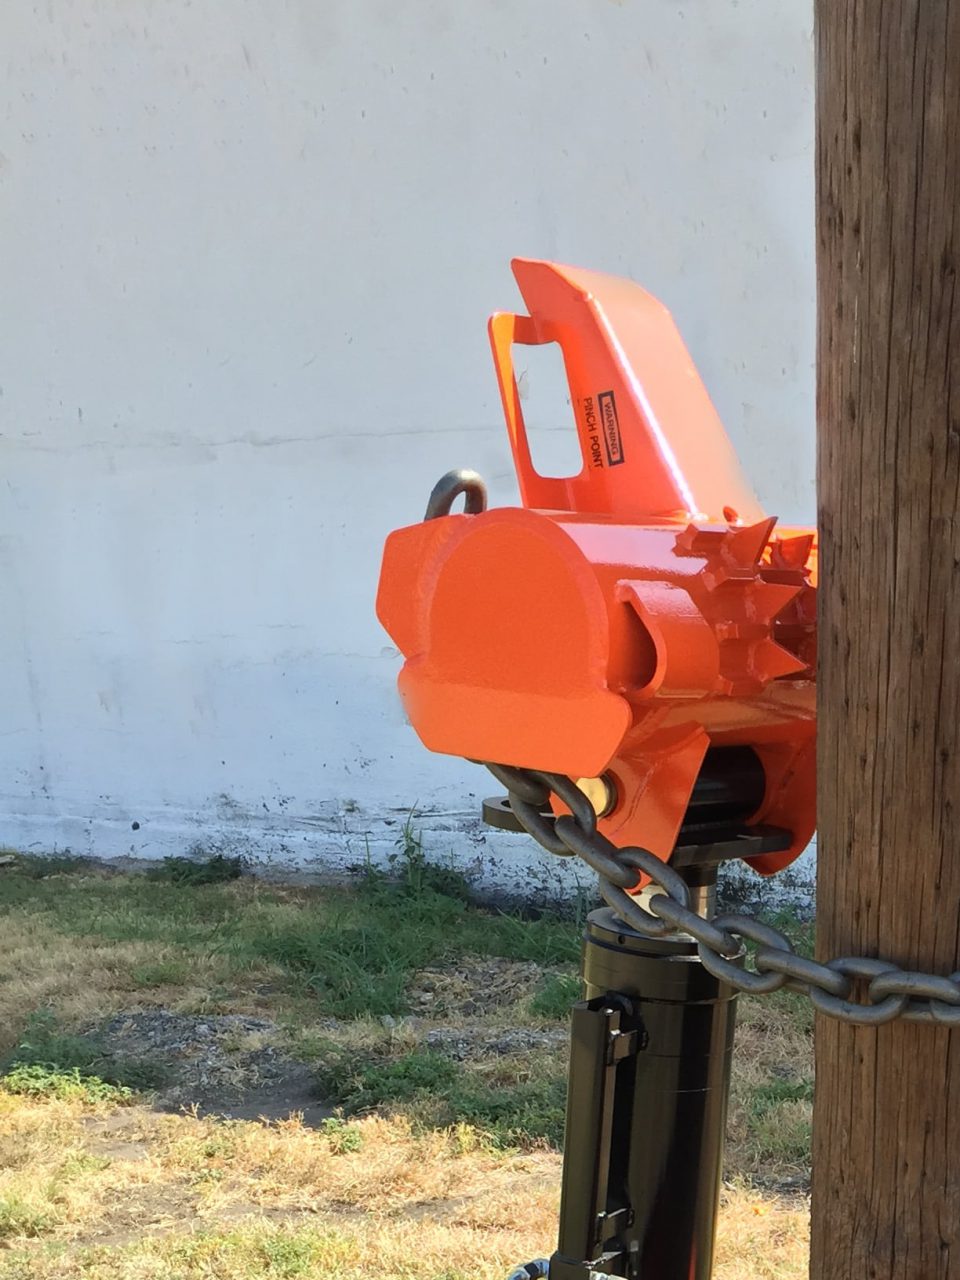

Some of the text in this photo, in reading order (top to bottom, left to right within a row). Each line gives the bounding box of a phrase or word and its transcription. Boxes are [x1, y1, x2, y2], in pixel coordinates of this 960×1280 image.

[584, 397, 603, 468] PINCH POINT
[604, 402, 619, 455] WARNING
